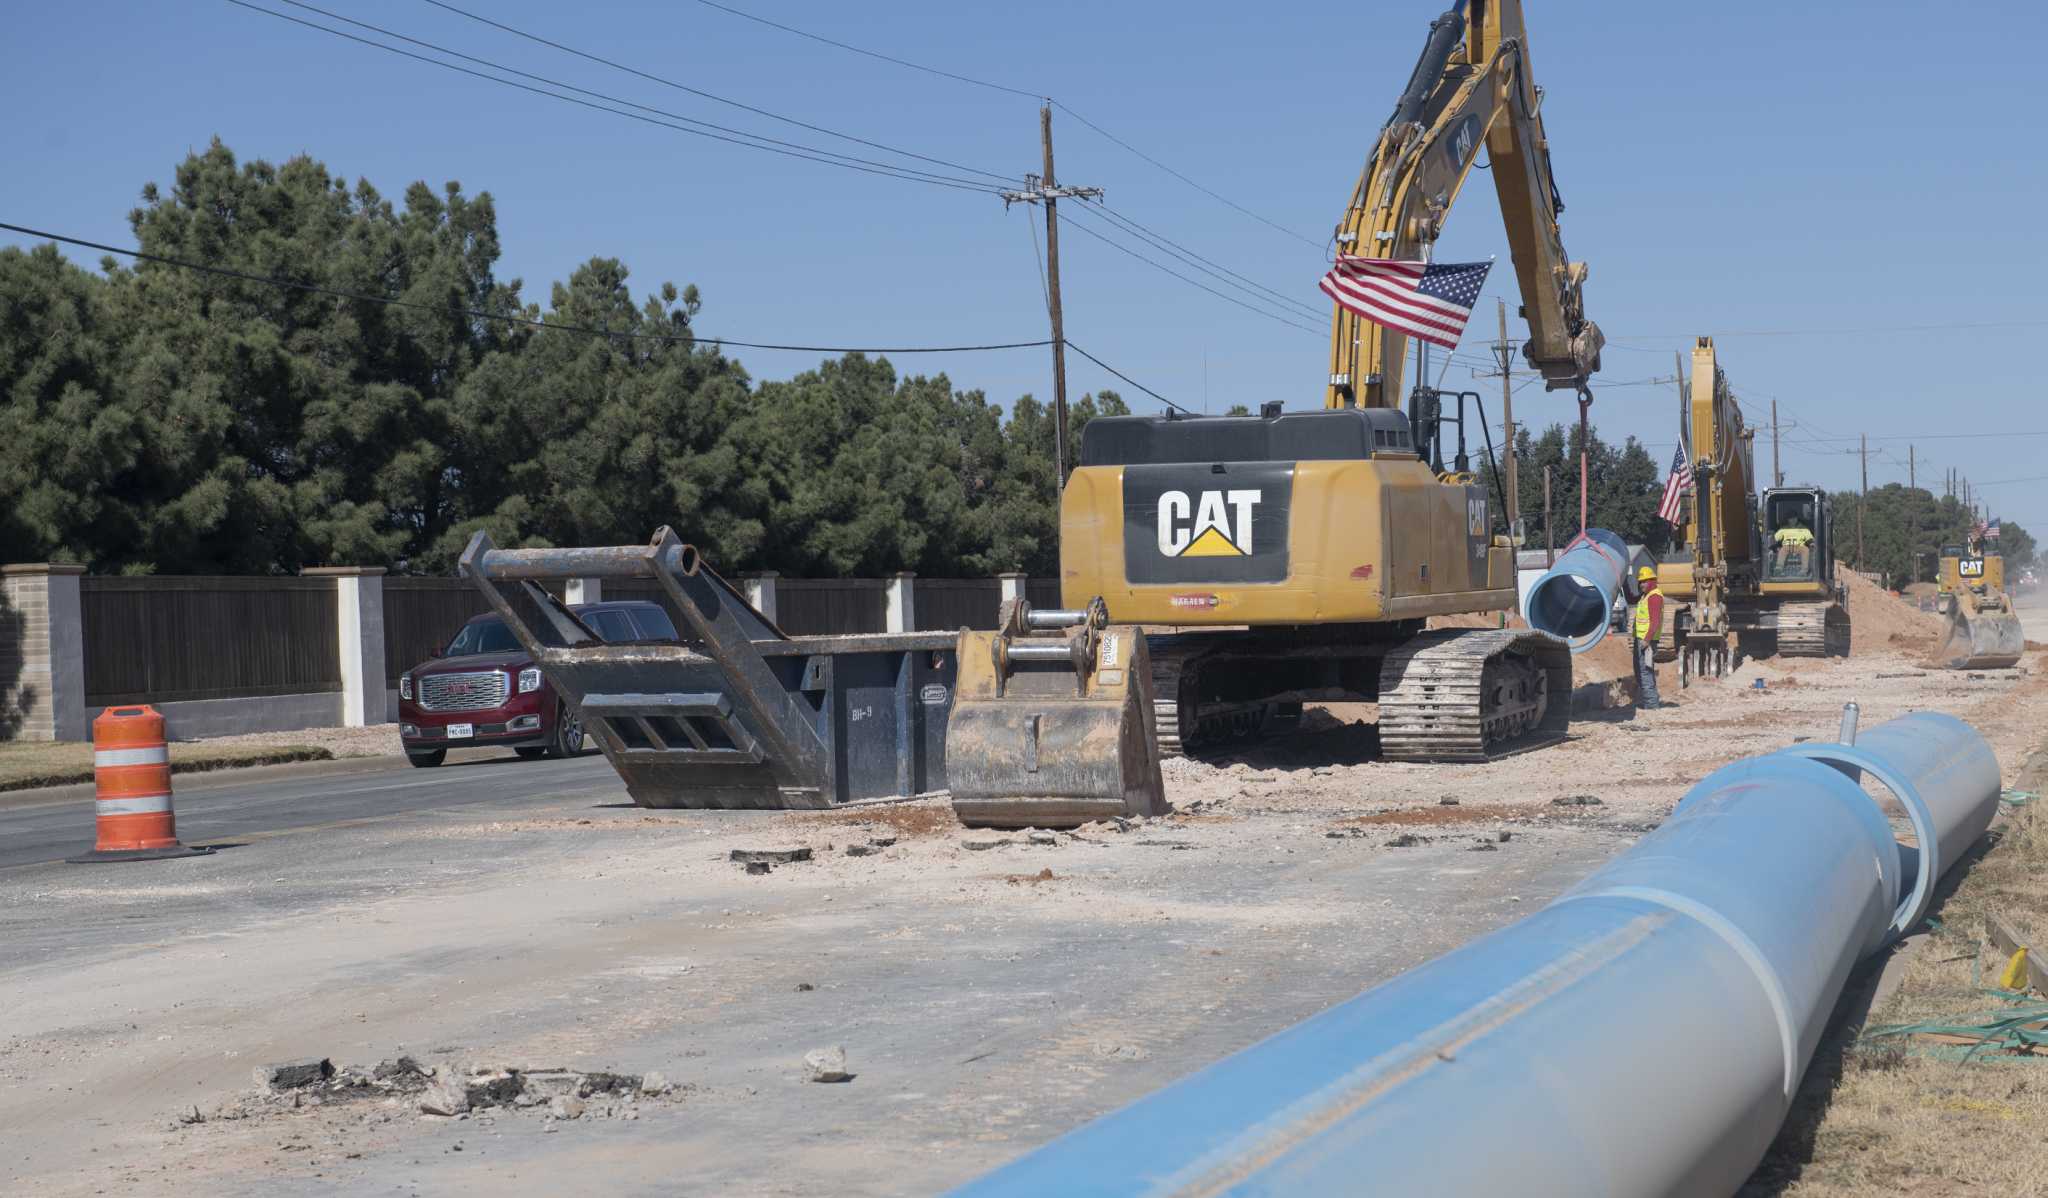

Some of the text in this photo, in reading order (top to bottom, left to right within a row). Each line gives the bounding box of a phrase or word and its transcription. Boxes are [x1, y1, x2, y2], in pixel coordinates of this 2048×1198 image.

[1158, 489, 1262, 557] CAT
[1468, 499, 1486, 536] CAT
[1960, 560, 1983, 576] CAT
